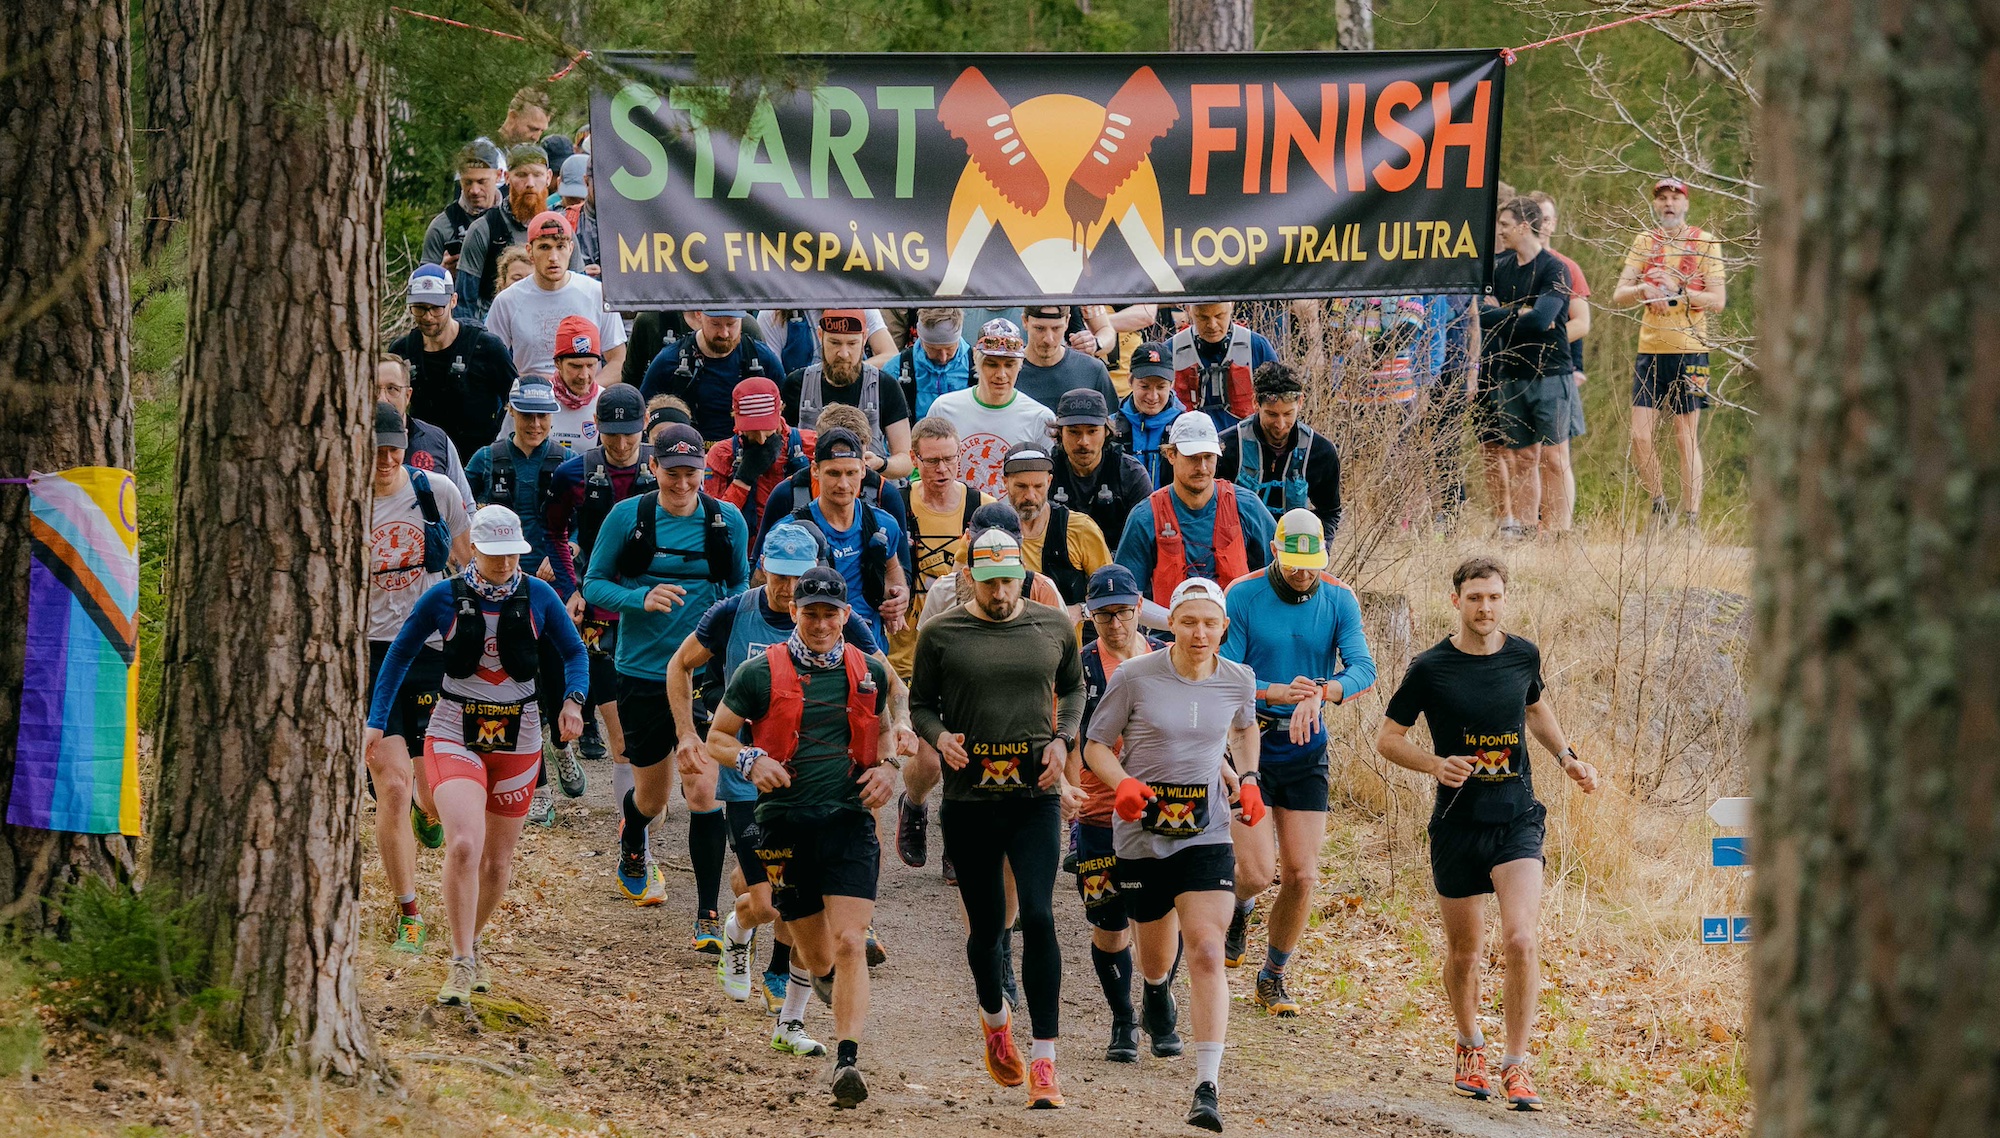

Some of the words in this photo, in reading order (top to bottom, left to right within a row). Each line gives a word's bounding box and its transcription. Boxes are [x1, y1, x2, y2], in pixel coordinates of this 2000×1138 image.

[609, 82, 936, 201] START
[1188, 80, 1492, 196] FINISH
[618, 232, 709, 273] MRC
[725, 220, 930, 272] FINSPÅNG
[1174, 226, 1268, 267] LOOP
[1278, 223, 1367, 265] TRAIL
[1377, 220, 1479, 261] ULTRA
[493, 527, 514, 536] 1901
[417, 694, 432, 706] 40
[465, 703, 476, 714] 69
[477, 703, 521, 716] STEPHANIE
[1465, 734, 1477, 746] 14
[1479, 732, 1519, 746] PONTUS
[973, 742, 990, 755] 62
[992, 742, 1029, 756] LINUS
[494, 787, 530, 806] 1901
[1167, 786, 1206, 799] WILLIAM
[755, 848, 793, 861] THOMMIE
